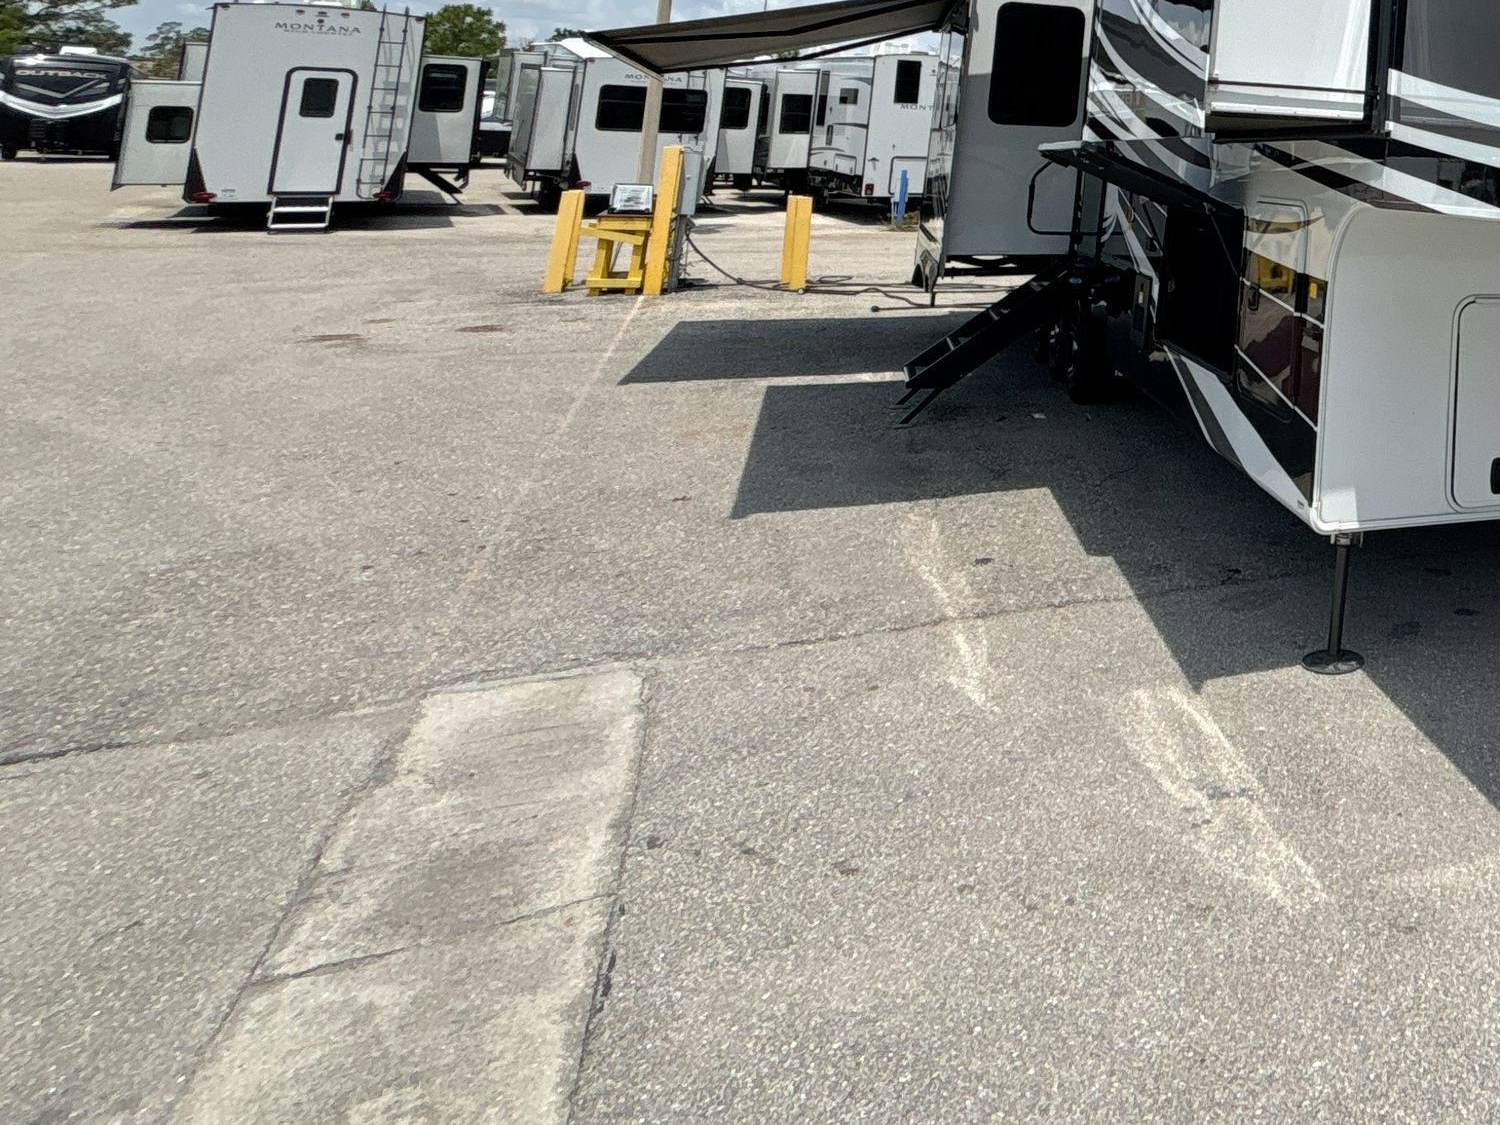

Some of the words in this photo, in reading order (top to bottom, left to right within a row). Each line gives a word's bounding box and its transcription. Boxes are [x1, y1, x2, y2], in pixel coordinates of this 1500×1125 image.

[274, 22, 361, 34] MONTANA
[14, 69, 107, 80] OUTBACK
[624, 73, 682, 83] MONANA
[899, 103, 935, 111] MONT
